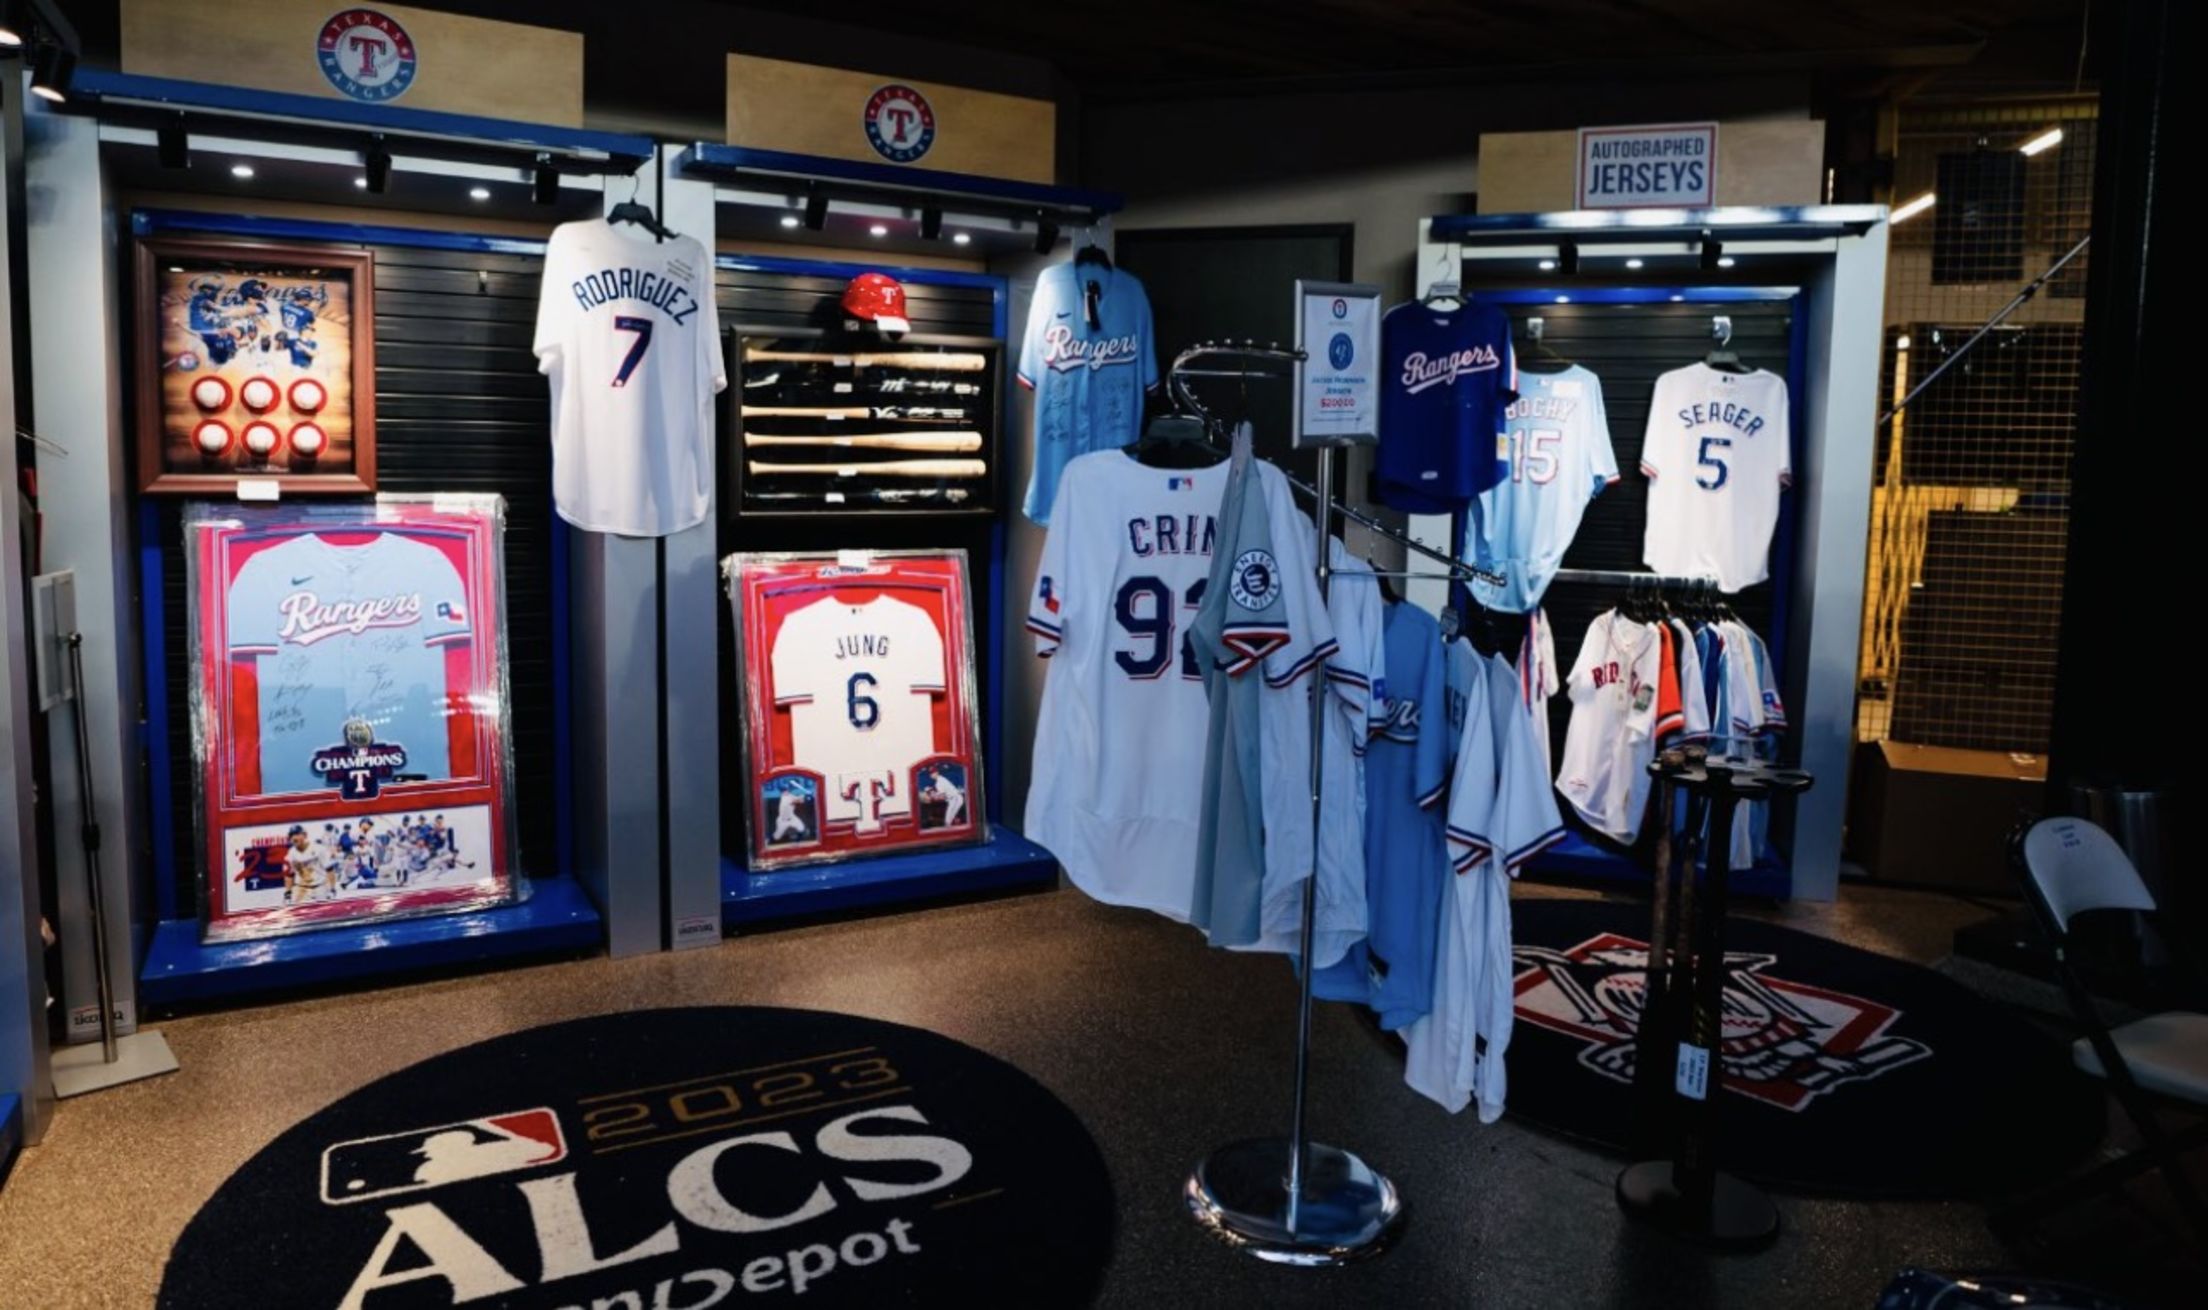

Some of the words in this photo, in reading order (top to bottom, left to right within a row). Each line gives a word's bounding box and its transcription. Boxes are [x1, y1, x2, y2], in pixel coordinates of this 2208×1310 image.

[332, 14, 402, 40] TEXAS
[325, 58, 411, 98] RANGERS
[349, 36, 387, 78] T
[887, 108, 915, 143] T
[1591, 138, 1704, 160] AUTOGRAPHED
[1589, 161, 1704, 195] JERSEYS
[572, 268, 699, 327] RODRIGUEZ
[882, 286, 897, 304] T
[611, 315, 654, 388] 7
[1044, 323, 1138, 371] Rangers
[1401, 343, 1500, 390] Rangers
[1505, 396, 1577, 422] BOCHY
[1678, 401, 1765, 438] SEAGER
[1511, 428, 1562, 486] 15
[1696, 437, 1732, 491] 5
[279, 590, 422, 640] Rangers
[835, 634, 891, 660] JUNG
[846, 671, 881, 733] 6
[315, 751, 404, 773] CHAMPIONS
[349, 769, 371, 793] T
[583, 1056, 899, 1142] 2023
[335, 1105, 973, 1310] ALCS
[554, 1218, 921, 1310] Depot
